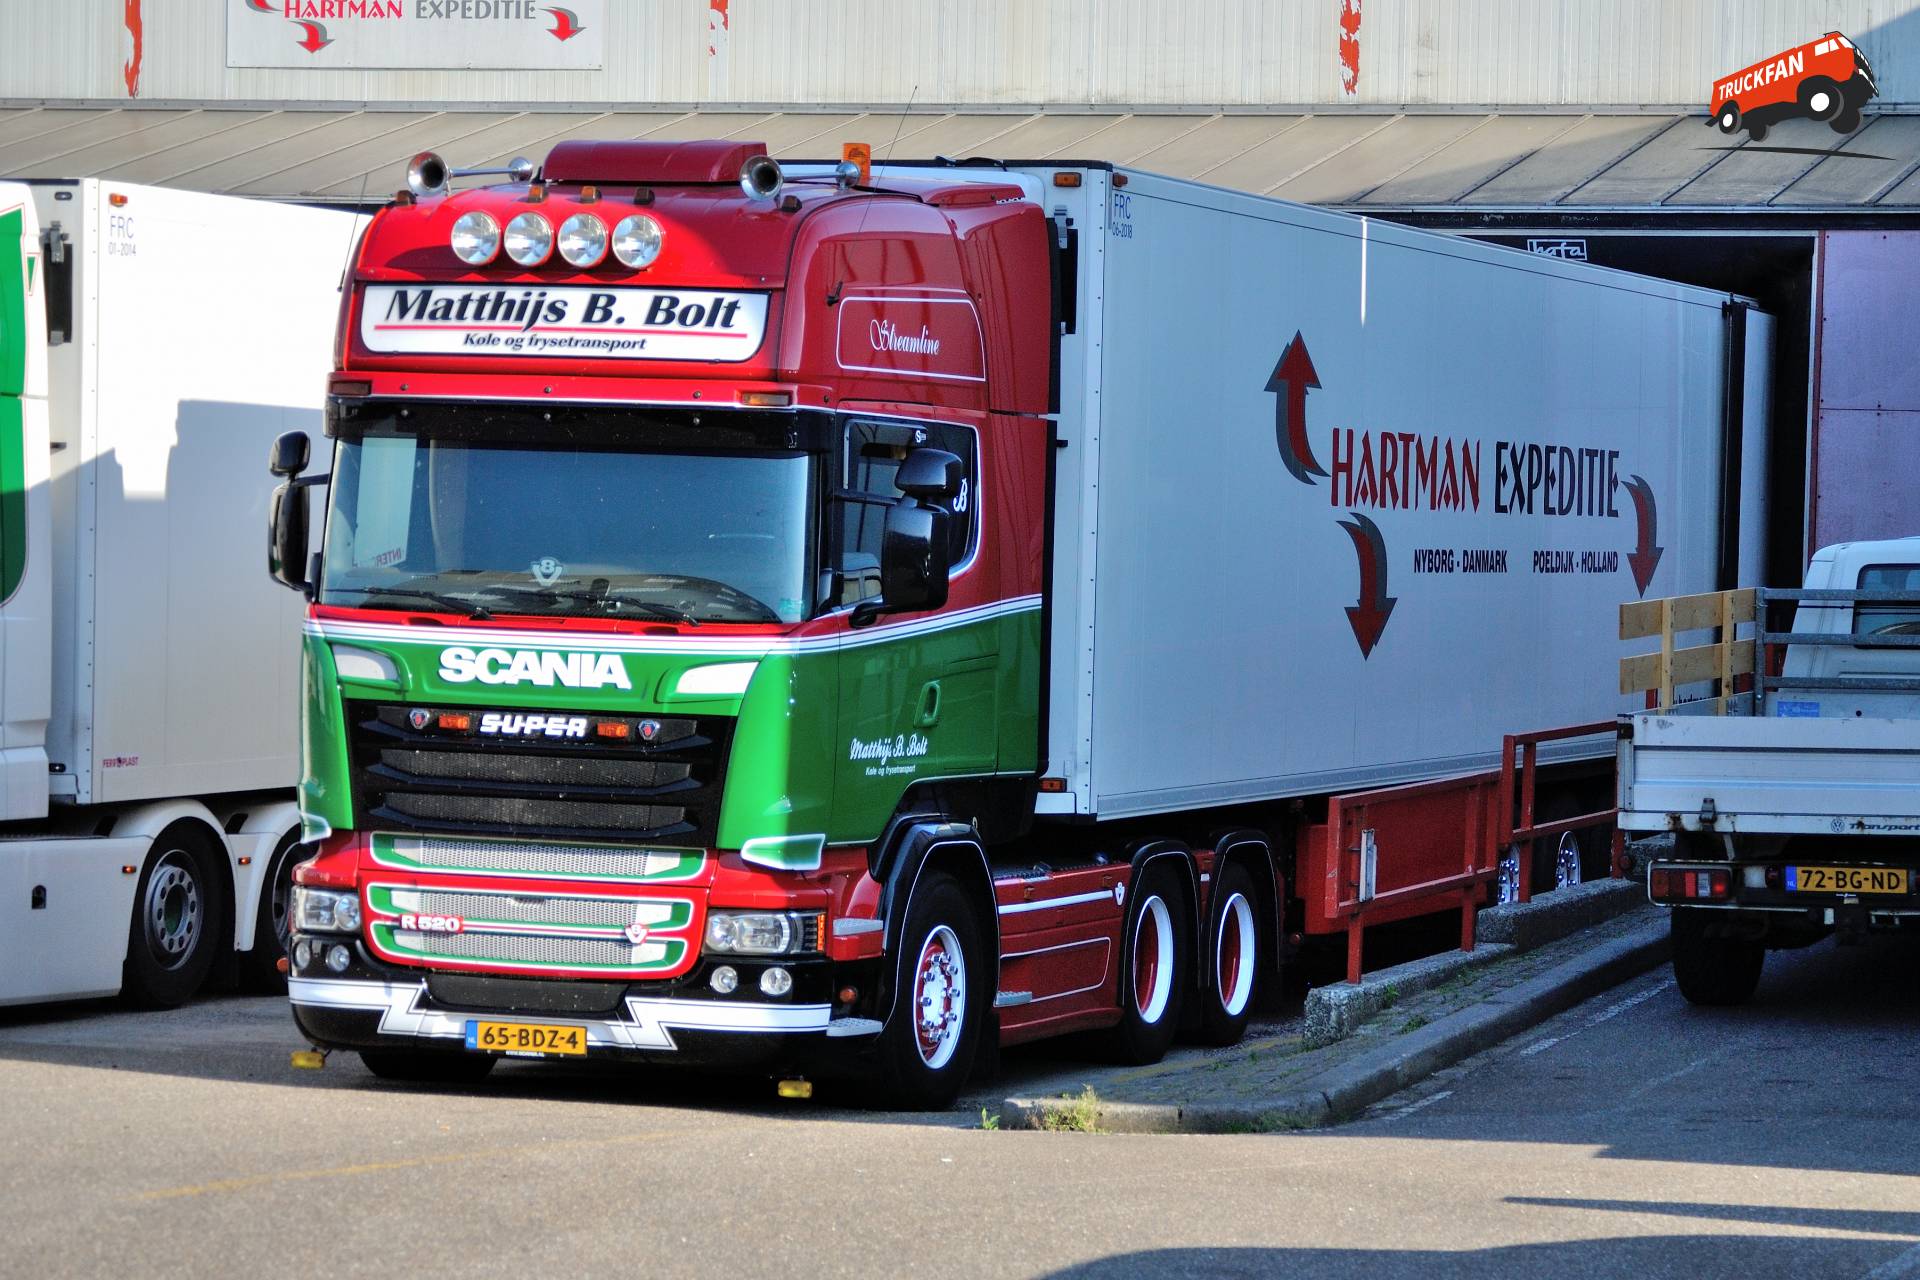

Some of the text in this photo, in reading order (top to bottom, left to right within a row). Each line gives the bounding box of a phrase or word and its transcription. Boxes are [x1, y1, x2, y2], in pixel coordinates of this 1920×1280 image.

[284, 0, 537, 20] HARTMAN EXPEDITIE
[1114, 193, 1131, 220] FRC
[110, 215, 134, 239] FRC
[386, 289, 742, 332] Matthijs B. Bolt
[504, 336, 526, 351] og
[527, 333, 648, 353] frysetransport
[869, 319, 941, 356] Streamline
[1331, 427, 1620, 518] HARTMAN EXPEDITIE
[1413, 549, 1454, 573] NYBORG
[1462, 549, 1508, 574] DANMARK
[1532, 550, 1575, 574] POELDIJK
[1580, 551, 1619, 574] HOLLAND
[438, 646, 632, 690] SCANIA
[480, 713, 588, 738] SUPER
[849, 732, 928, 765] Matthijs B. Bolt
[1801, 869, 1901, 891] 72-BG-ND
[401, 915, 417, 929] R
[483, 1026, 579, 1050] 65-BDZ-4
